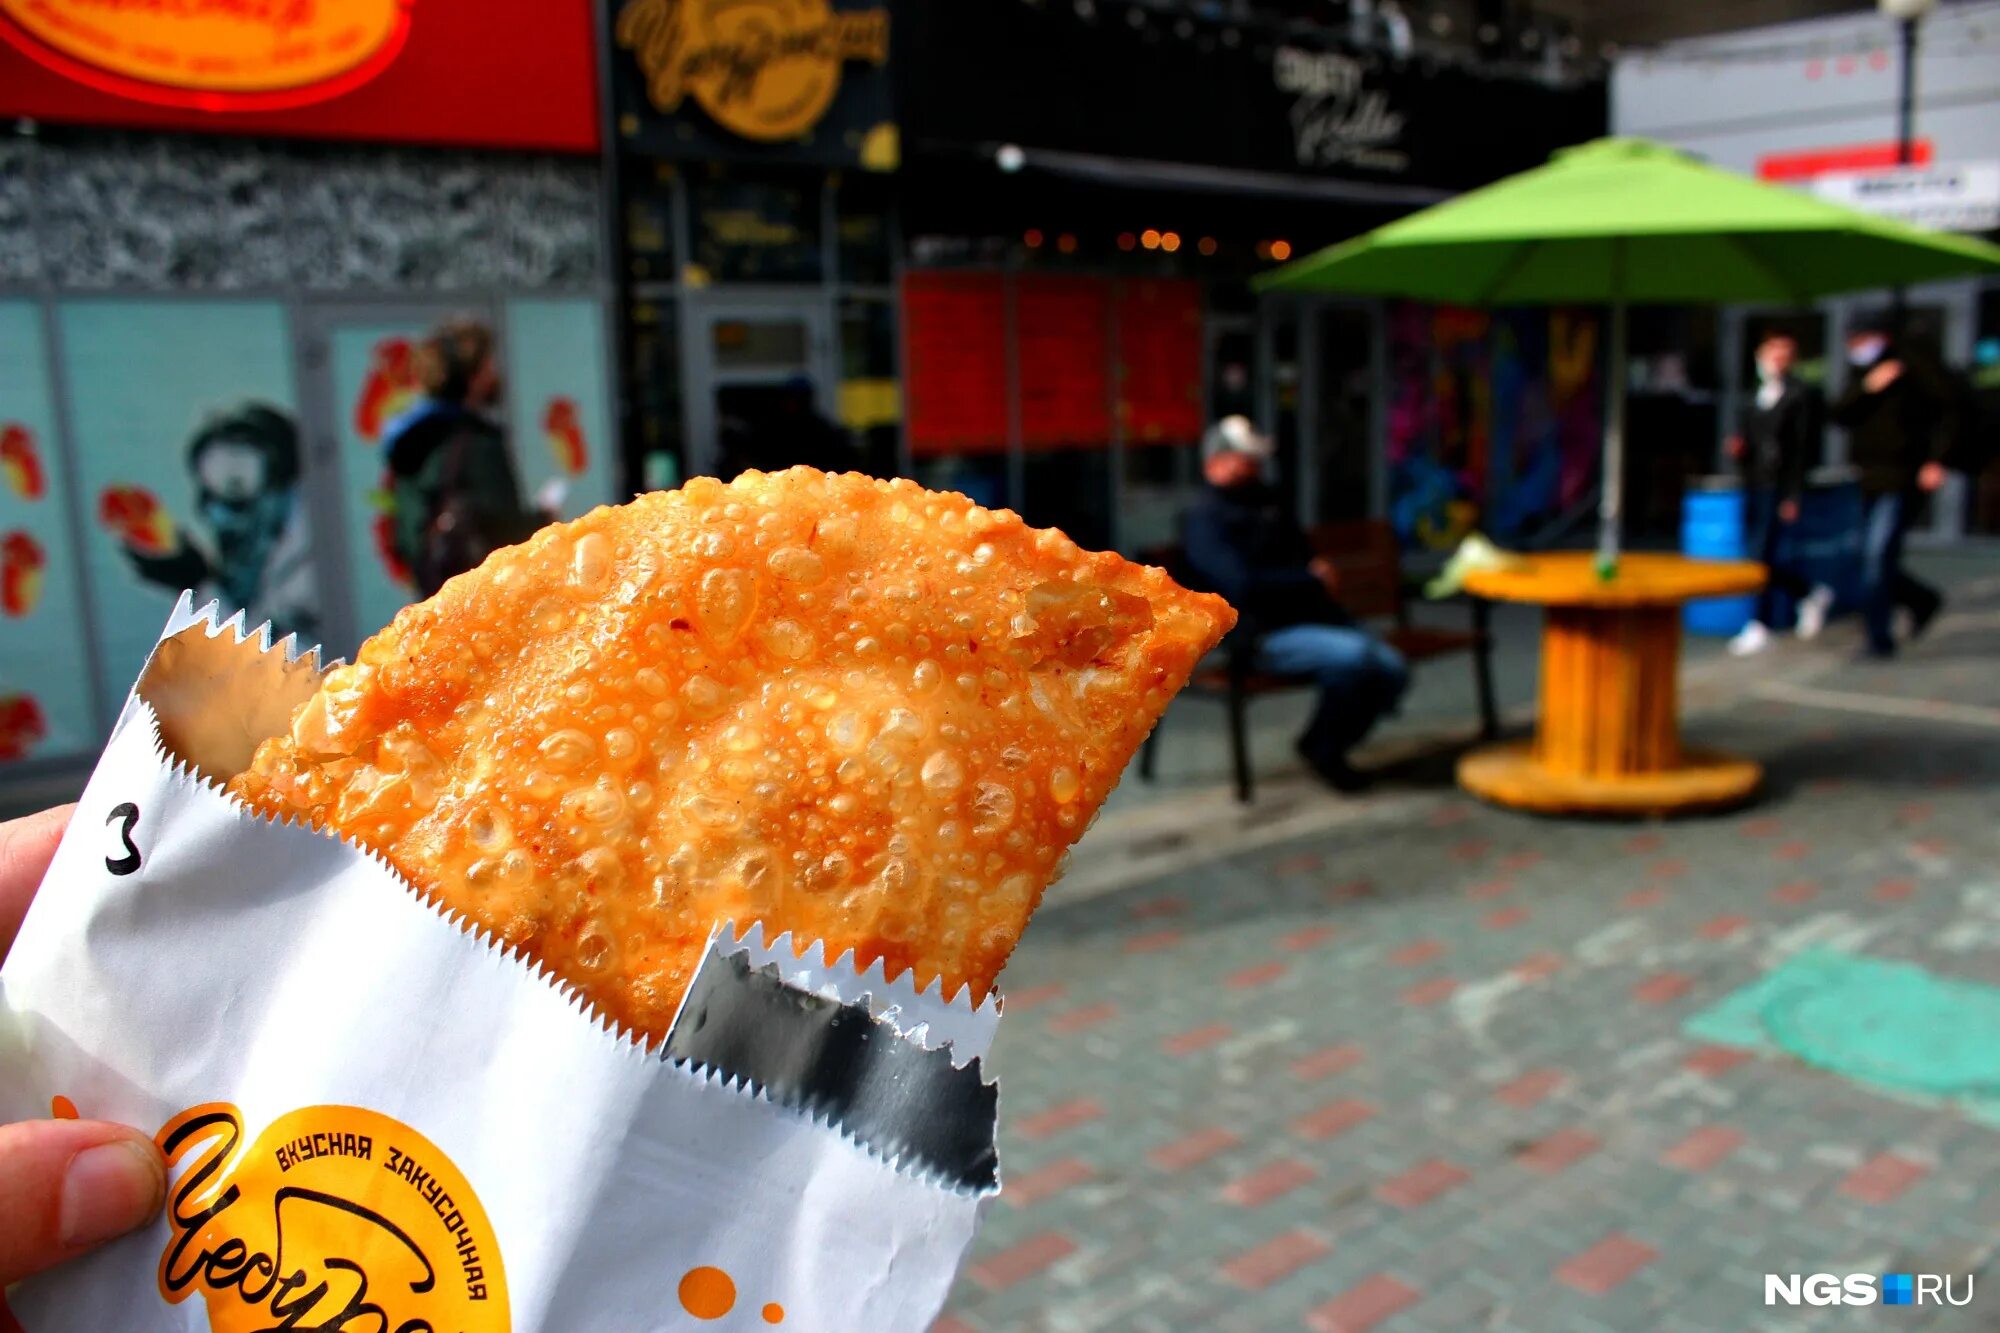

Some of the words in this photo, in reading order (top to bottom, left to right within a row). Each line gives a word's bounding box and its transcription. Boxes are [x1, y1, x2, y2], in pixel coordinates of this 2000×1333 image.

[105, 802, 142, 876] 3
[275, 1132, 372, 1173] ВКУСНАЯ
[384, 1146, 488, 1301] ЗАКУСОЧНАЯ
